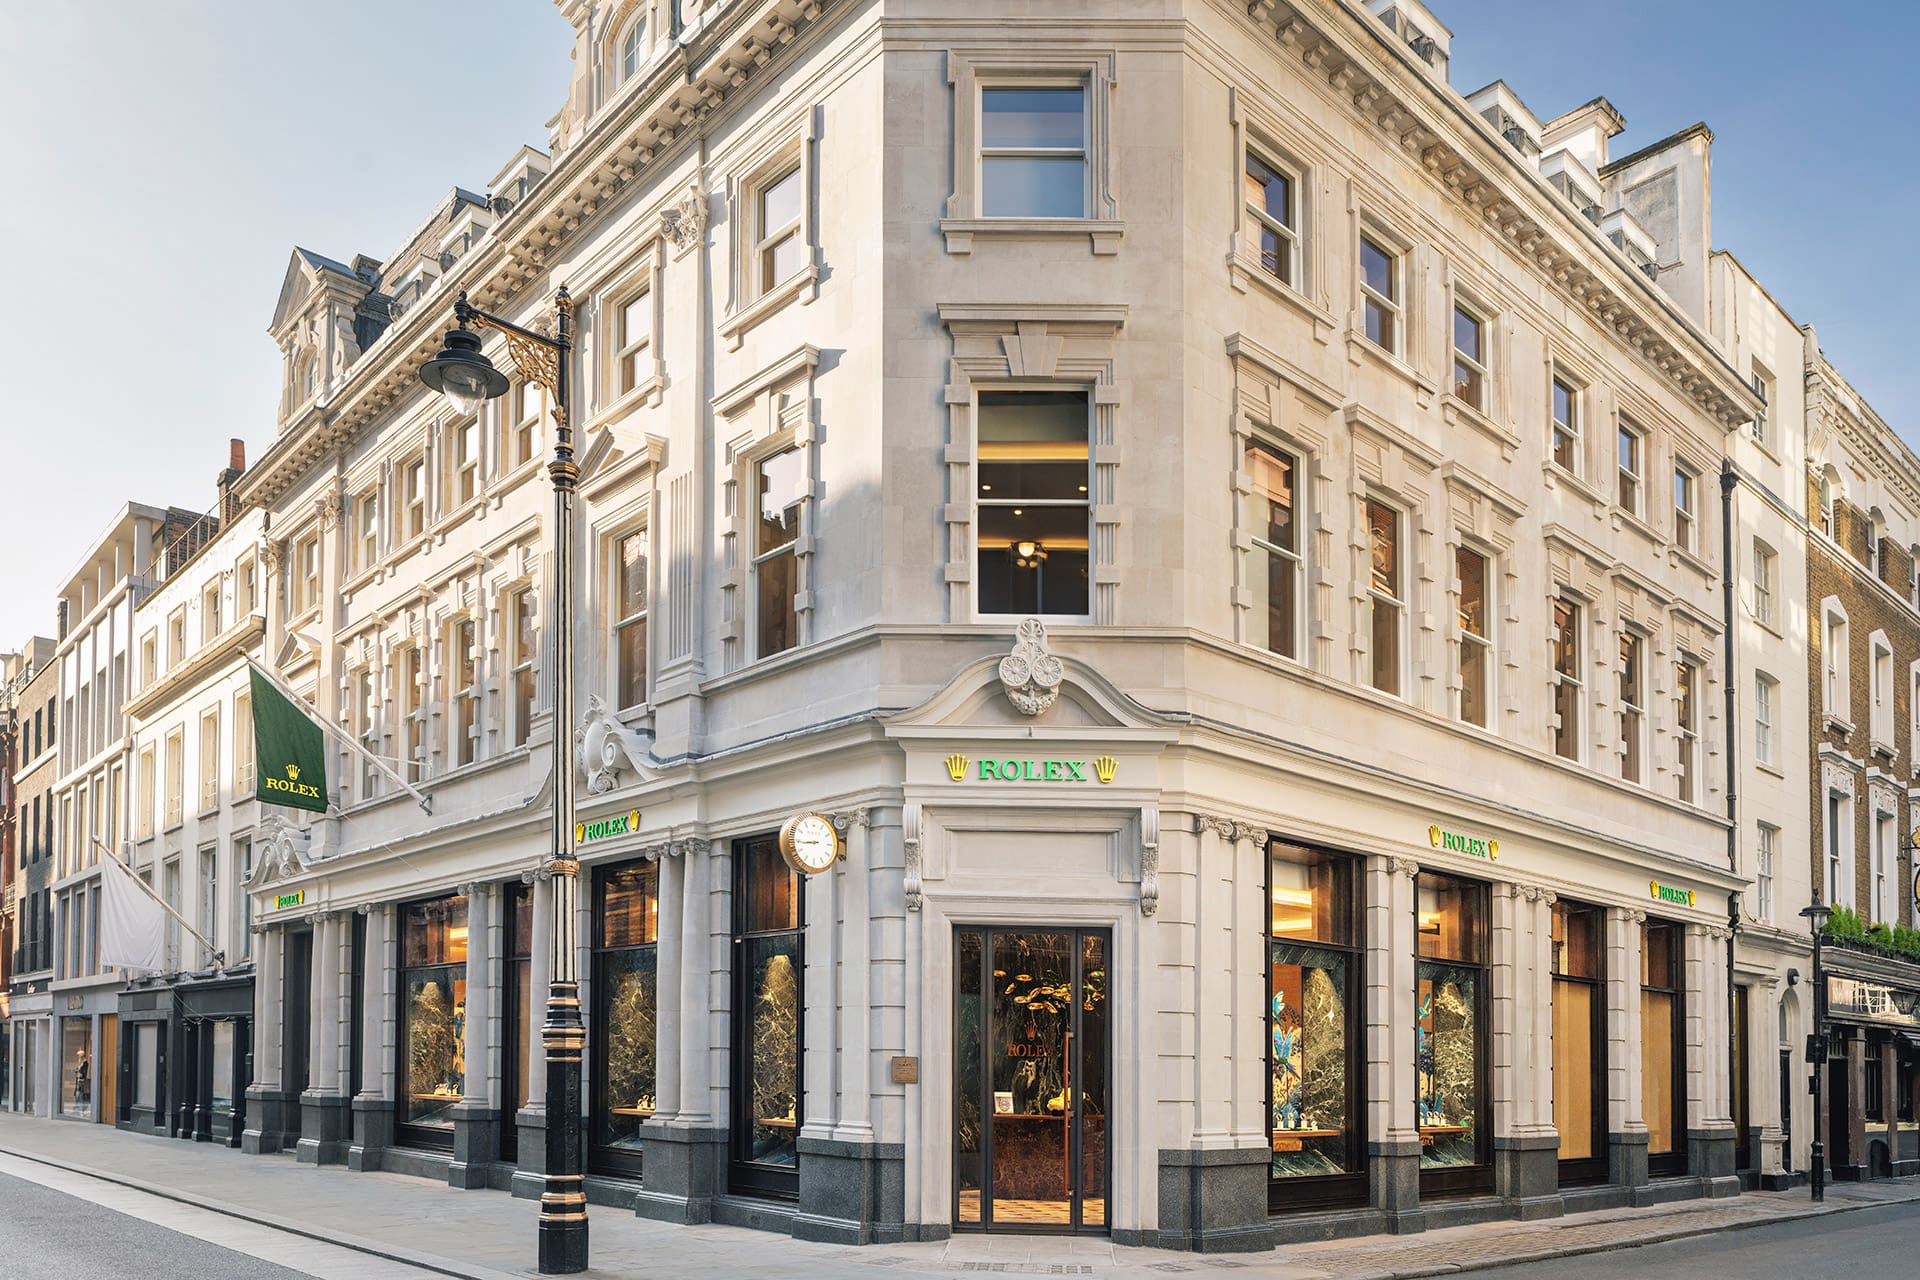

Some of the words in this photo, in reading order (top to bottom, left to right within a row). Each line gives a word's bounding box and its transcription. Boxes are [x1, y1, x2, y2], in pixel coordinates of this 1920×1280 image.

[978, 759, 1088, 781] ROLEX
[265, 777, 320, 798] ROLEX
[585, 816, 627, 840] ROLEX
[1443, 831, 1487, 857] ROLEX
[1659, 885, 1688, 904] ROLEX
